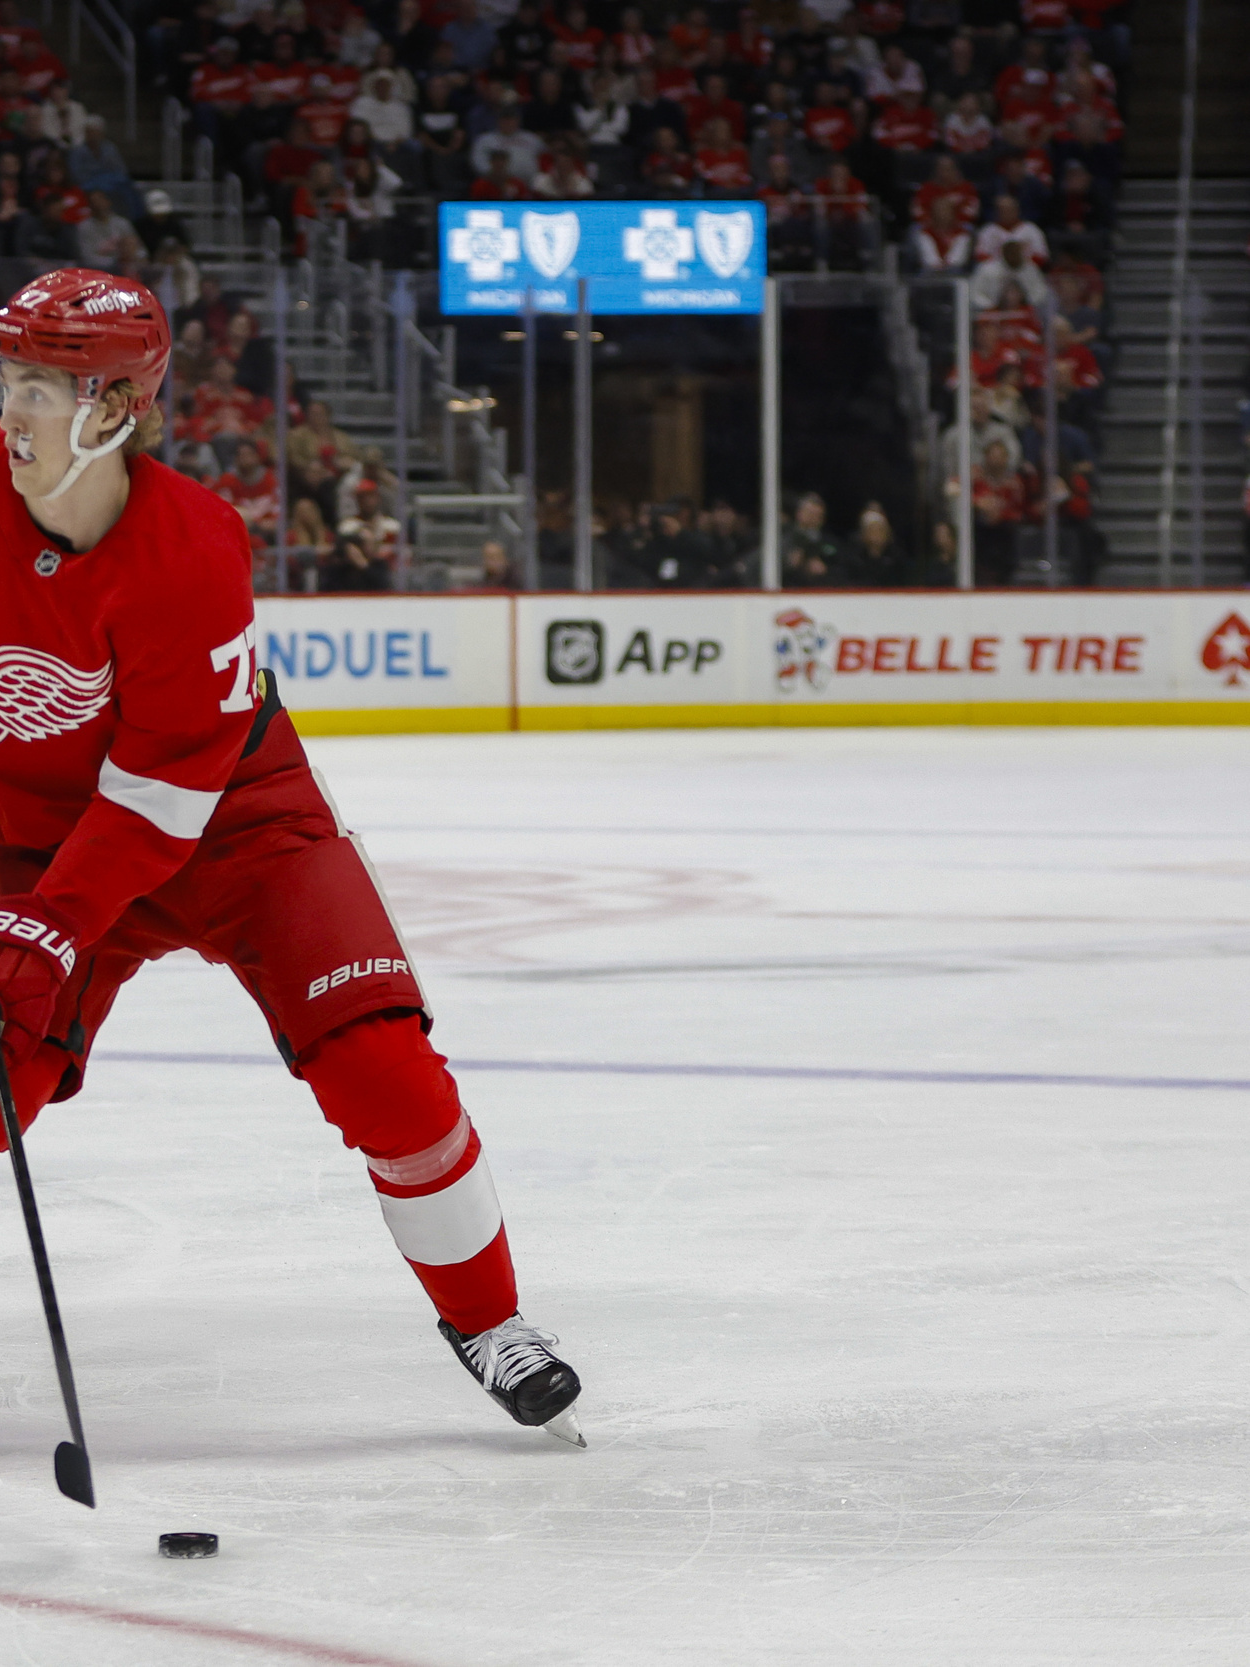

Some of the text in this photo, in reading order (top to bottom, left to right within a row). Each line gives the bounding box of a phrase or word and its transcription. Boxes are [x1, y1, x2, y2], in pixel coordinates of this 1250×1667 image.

[83, 288, 142, 316] meijer
[265, 630, 448, 679] NDUEL
[616, 630, 723, 674] App
[835, 636, 1146, 674] BELLE TIRE
[306, 957, 410, 1001] BAUER
